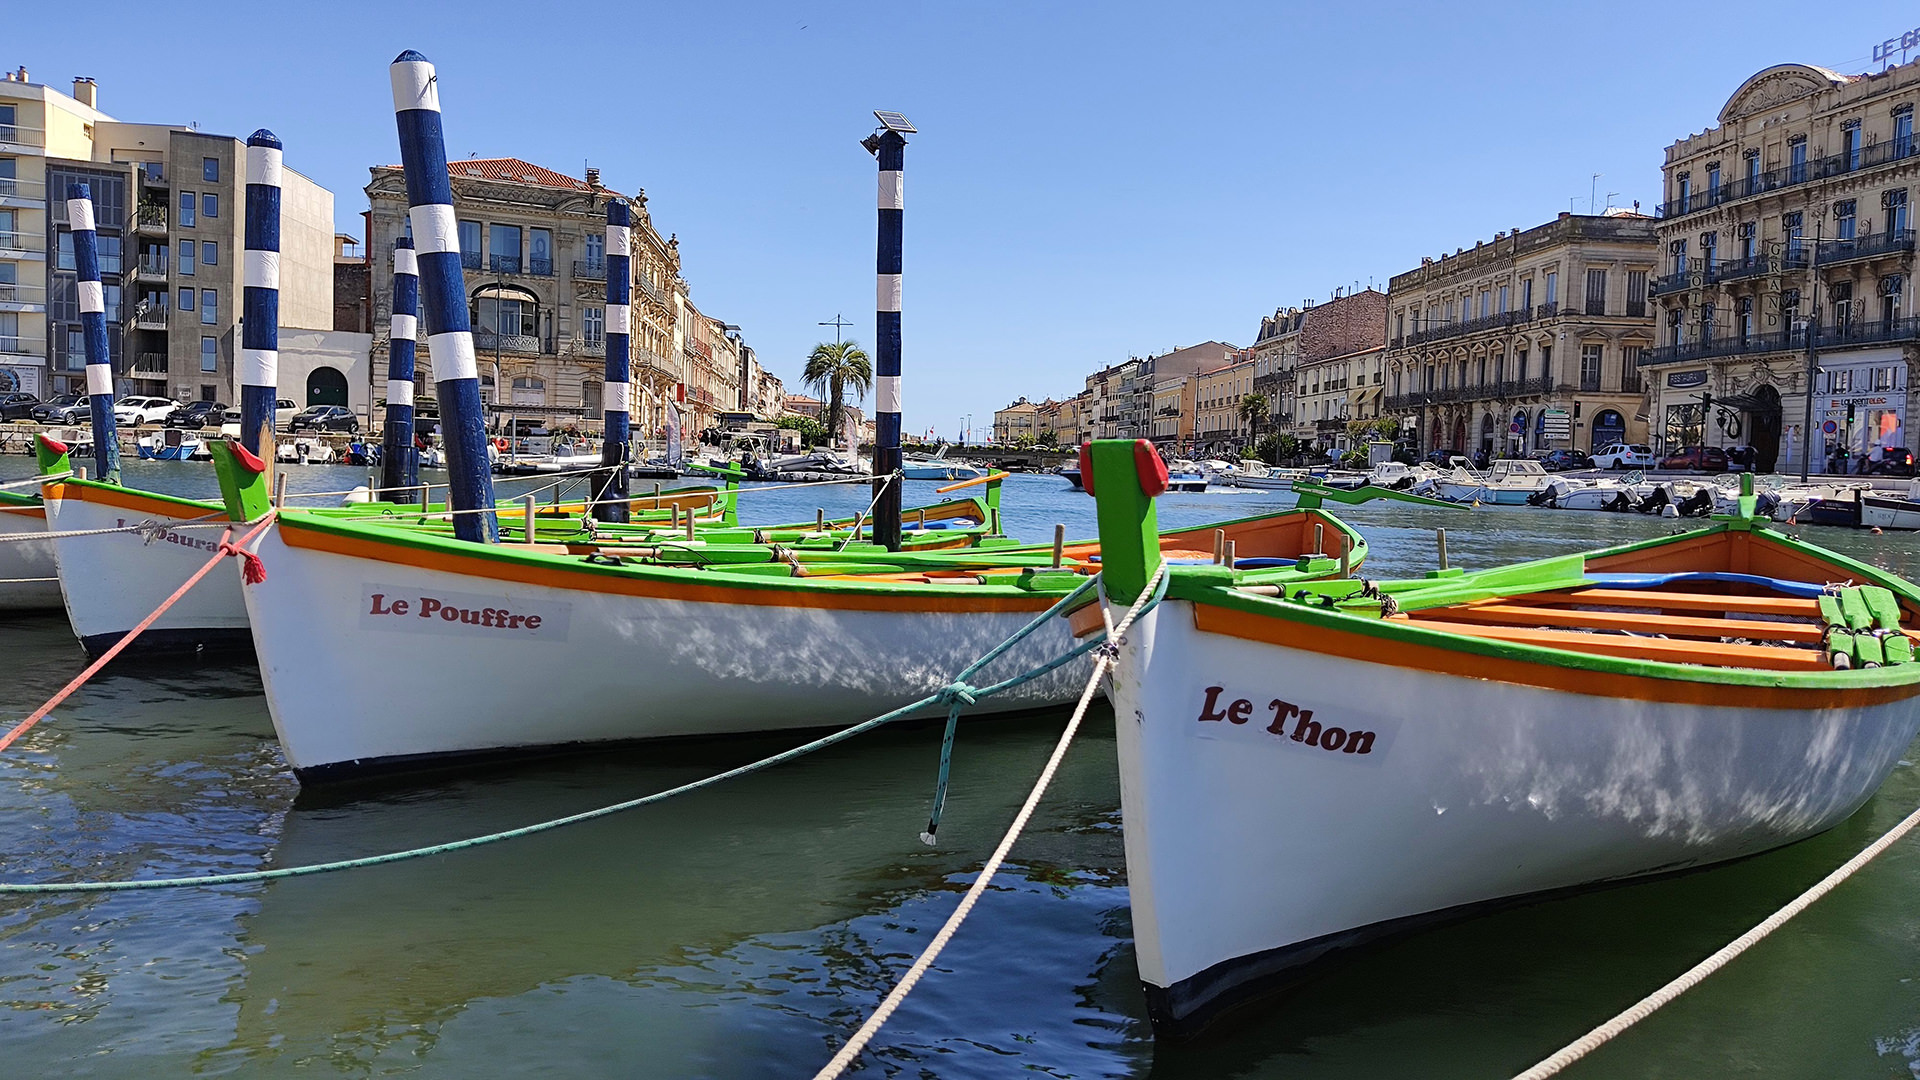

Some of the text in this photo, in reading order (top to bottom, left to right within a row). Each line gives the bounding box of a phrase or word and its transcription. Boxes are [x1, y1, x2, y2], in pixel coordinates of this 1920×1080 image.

[1873, 38, 1894, 63] LE
[1690, 259, 1703, 336] HOTEL
[1768, 244, 1780, 326] GRAND
[369, 593, 542, 630] Le Pouffre
[1198, 686, 1377, 755] Le Thon
